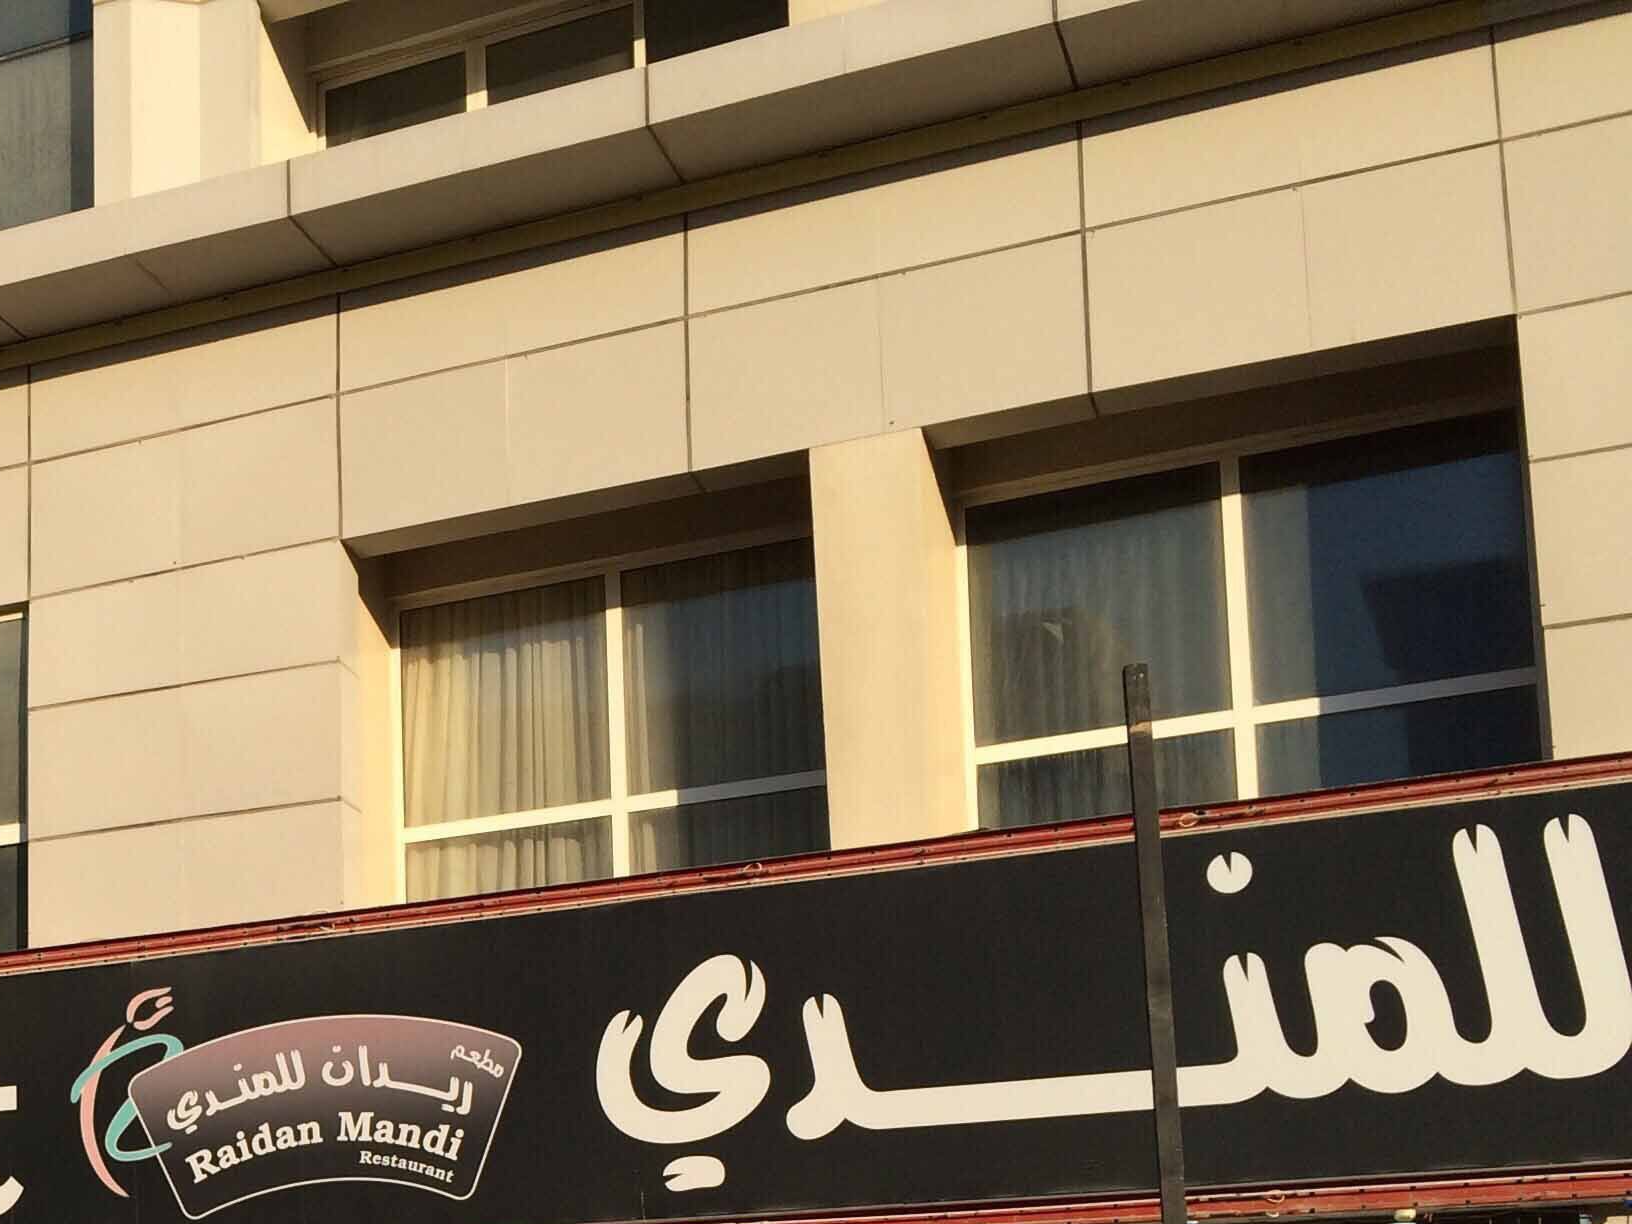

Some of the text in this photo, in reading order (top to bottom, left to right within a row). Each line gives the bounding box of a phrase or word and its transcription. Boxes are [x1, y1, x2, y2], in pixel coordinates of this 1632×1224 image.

[450, 1045, 504, 1078] مطعم
[185, 1111, 465, 1184] Raidan Mandi
[359, 1150, 455, 1183] Restaurant
